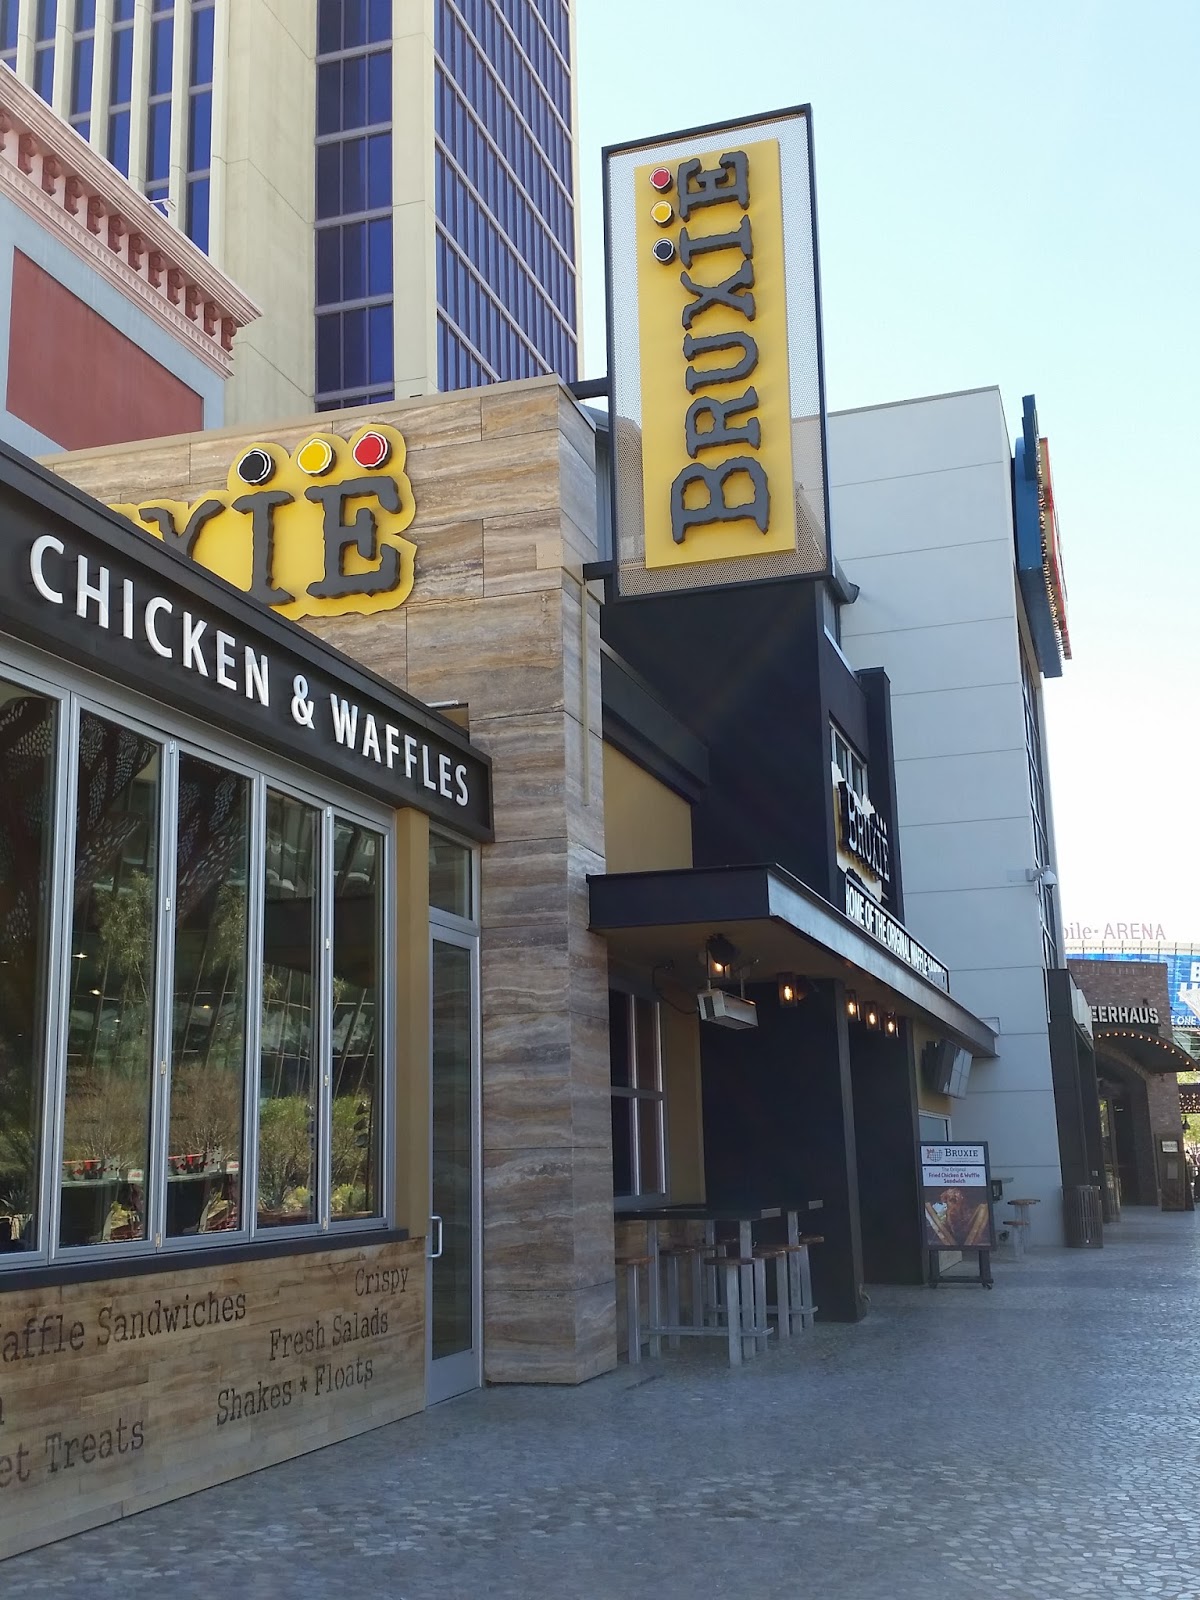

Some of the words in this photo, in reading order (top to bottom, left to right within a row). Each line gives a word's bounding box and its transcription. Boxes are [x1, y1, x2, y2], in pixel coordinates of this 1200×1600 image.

[670, 150, 771, 545] BRUXIE
[29, 534, 272, 708] CHICKEN
[290, 674, 315, 729] &
[330, 692, 470, 807] WAFFLES
[846, 884, 864, 926] HOME
[865, 900, 875, 935] OF
[874, 908, 887, 942] THE
[1103, 923, 1166, 940] ARENA
[1177, 1015, 1196, 1026] ONE
[945, 1148, 979, 1157] BRUXIE
[354, 1264, 410, 1297] Crispy
[96, 1290, 248, 1347] Sandwiches
[269, 1324, 326, 1362] Fresh
[332, 1307, 389, 1347] Salads
[216, 1377, 293, 1427] Shakes
[314, 1356, 374, 1396] Floats
[44, 1417, 146, 1474] Treats
